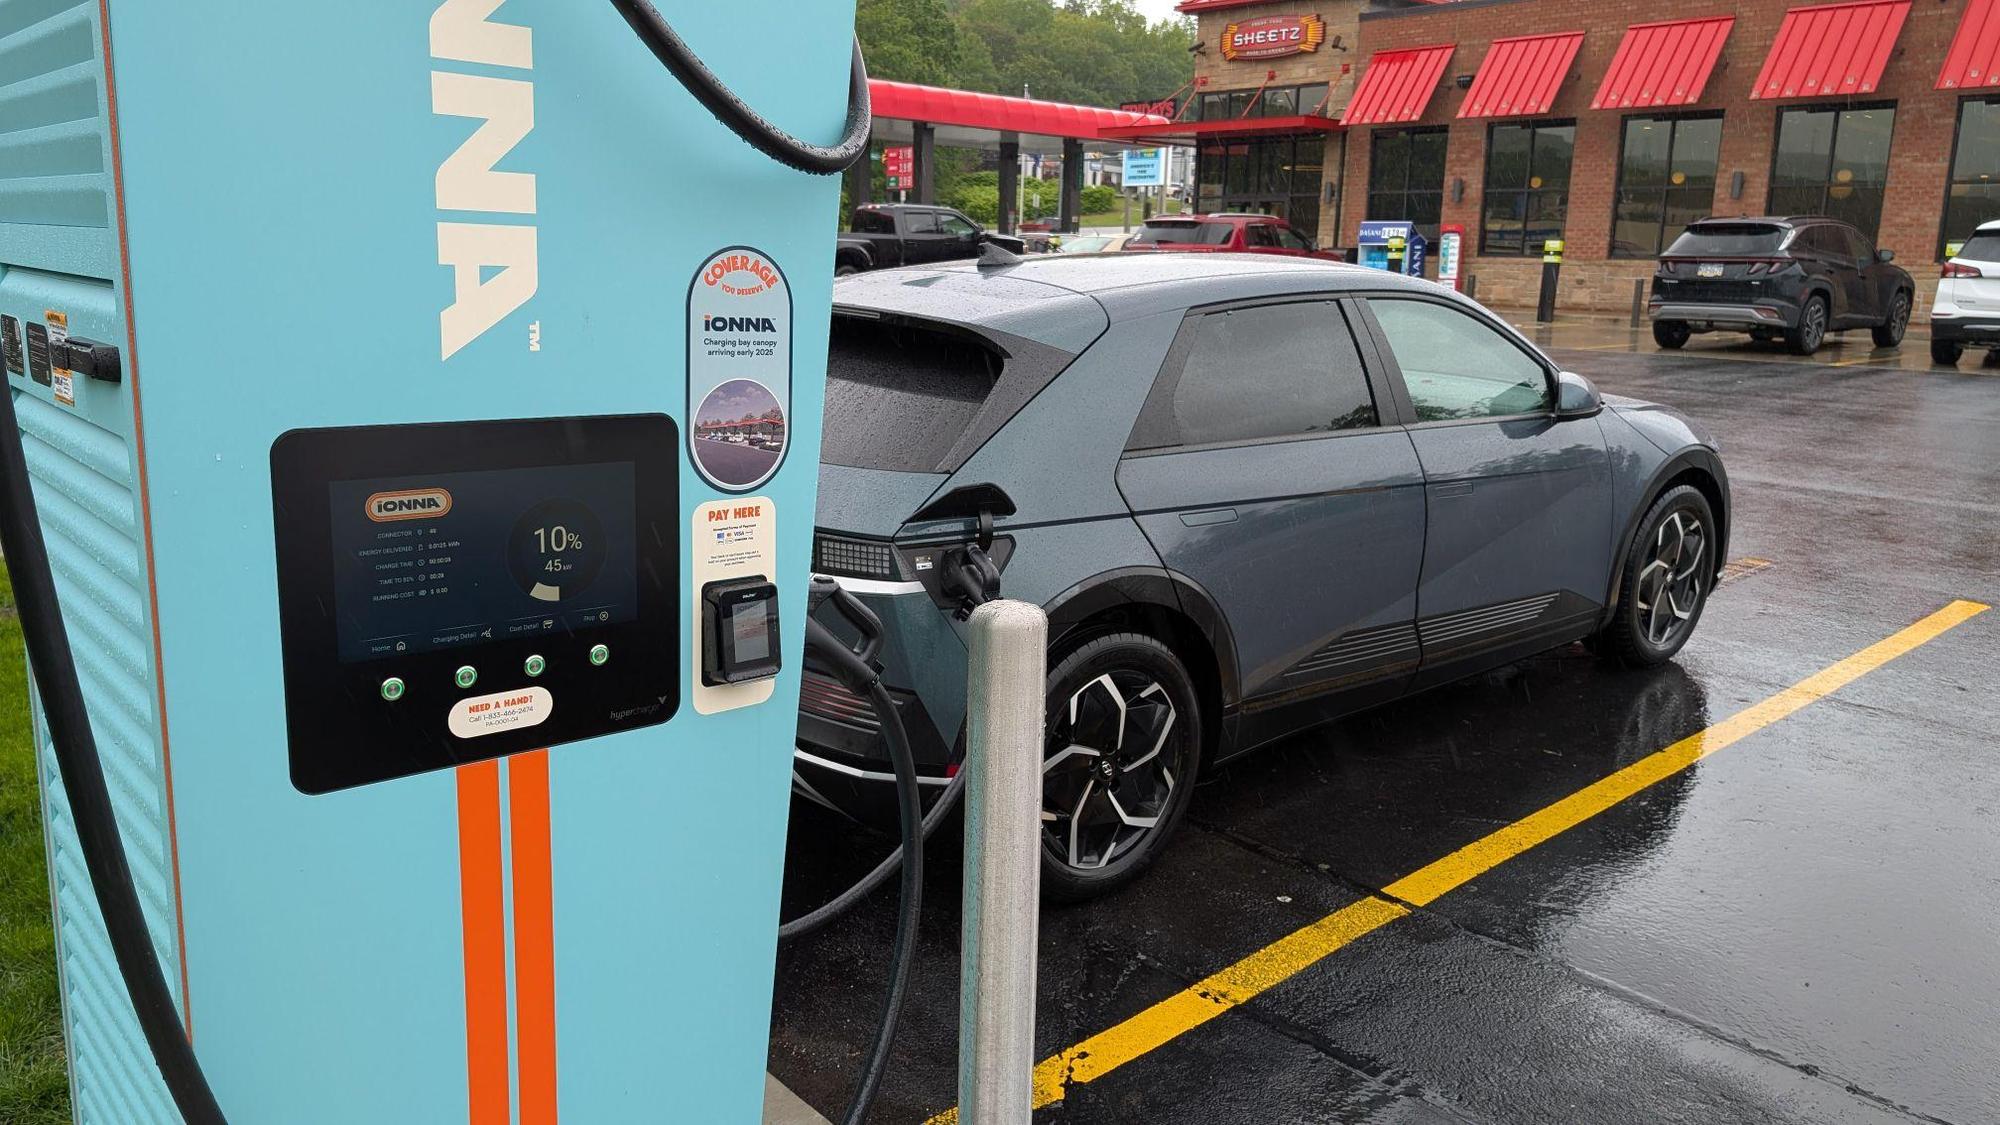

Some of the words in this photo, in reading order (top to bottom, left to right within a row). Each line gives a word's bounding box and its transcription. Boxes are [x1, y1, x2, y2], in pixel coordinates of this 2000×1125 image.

[1233, 27, 1300, 46] SHEETZ
[1359, 229, 1381, 237] DASANI
[703, 255, 779, 289] COVERAGE
[721, 284, 736, 295] YOU
[737, 284, 764, 296] DESERVE
[704, 338, 737, 348] Charging
[738, 338, 751, 348] bay
[752, 338, 777, 347] canopy
[707, 349, 735, 358] arriving
[736, 349, 754, 357] early
[755, 348, 774, 356] 2025
[708, 509, 729, 522] PAY
[733, 505, 761, 519] HERE
[377, 530, 413, 539] CONNECTOR
[534, 525, 583, 554] 10%
[544, 559, 562, 572] 45
[509, 624, 522, 632] Cost
[523, 622, 540, 630] Detail
[432, 634, 459, 644] Charging
[460, 631, 477, 640] Detail
[371, 645, 391, 653] Home
[468, 702, 491, 714] NEED
[493, 701, 501, 710] A
[503, 695, 534, 708] HAND?
[468, 714, 482, 723] Call
[483, 705, 534, 720] 1-833-466-2474
